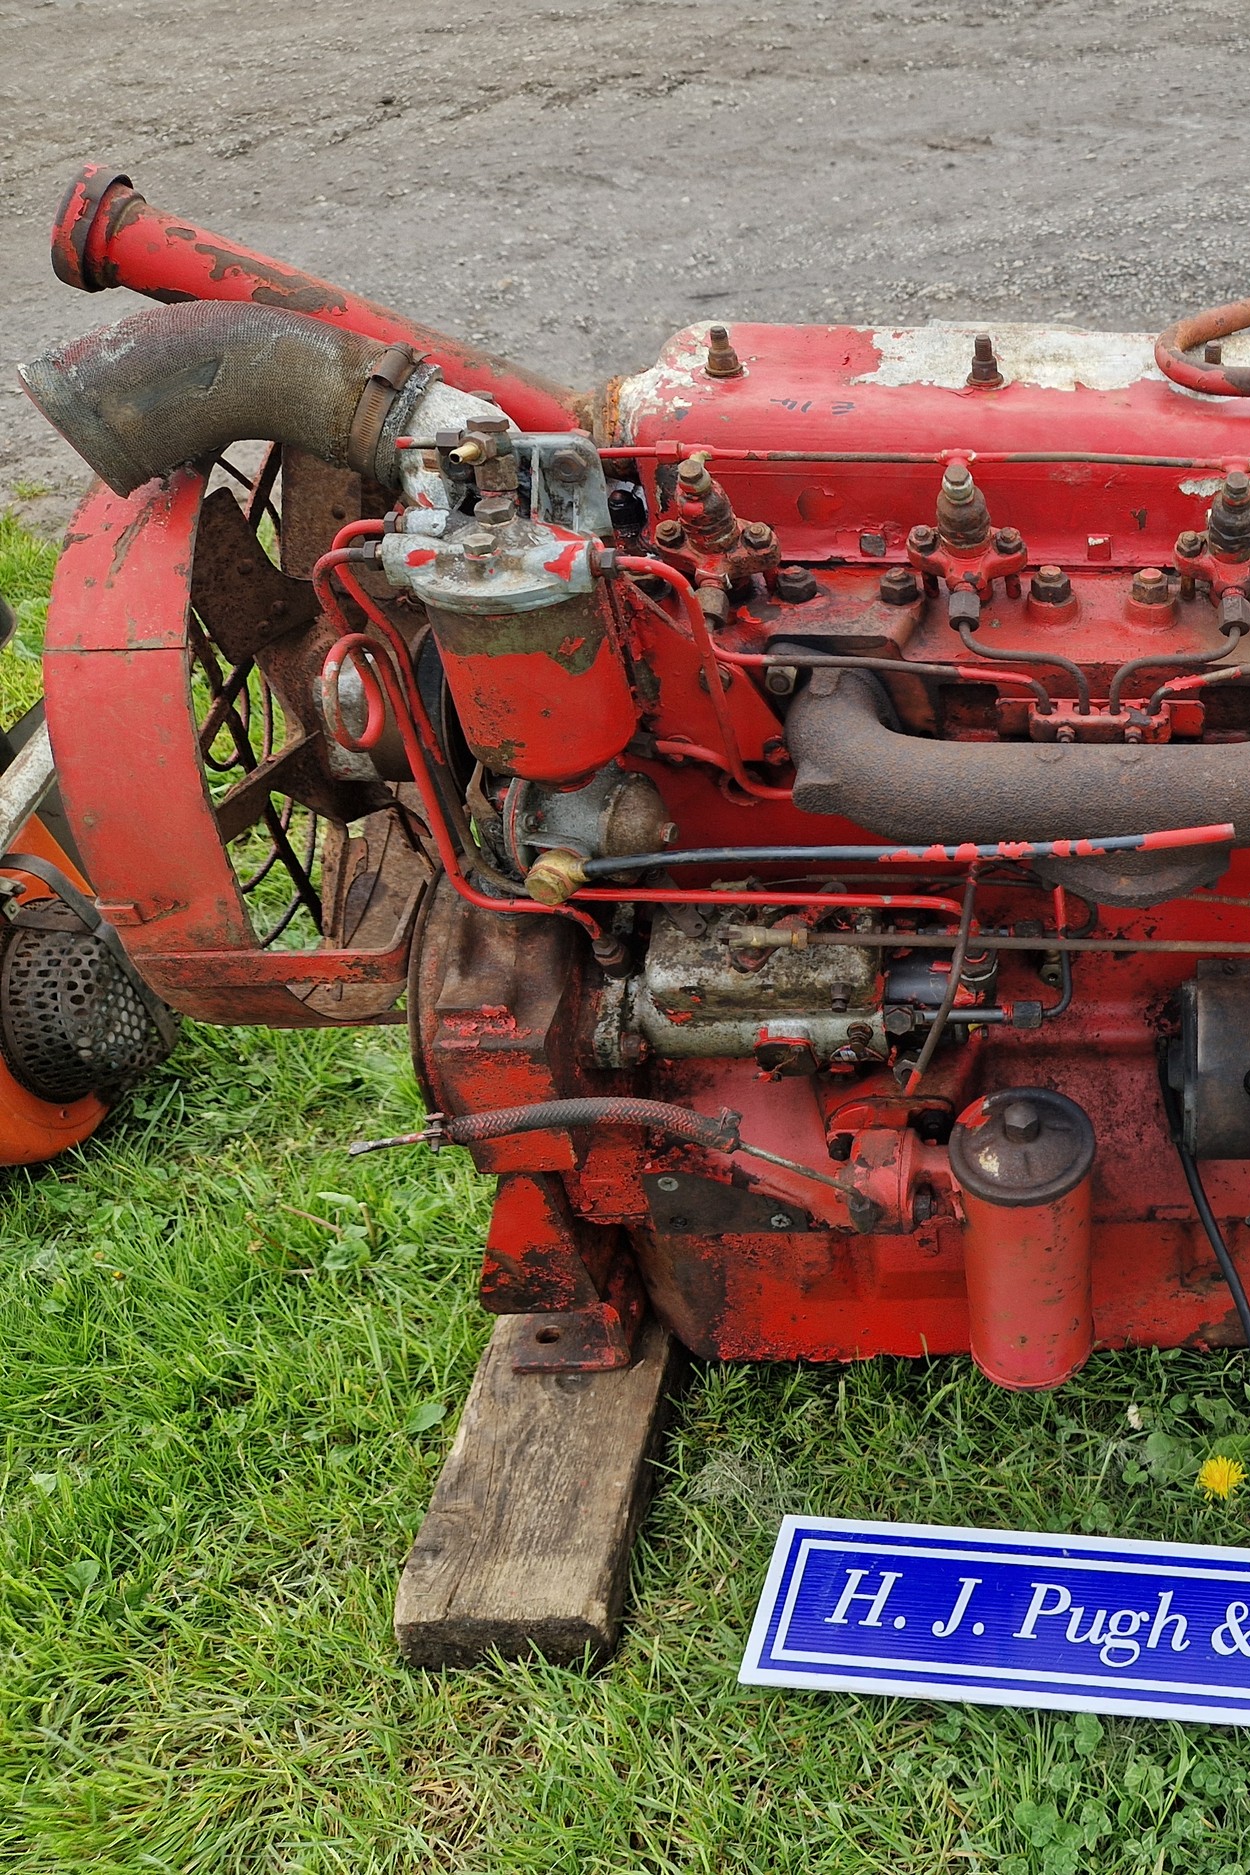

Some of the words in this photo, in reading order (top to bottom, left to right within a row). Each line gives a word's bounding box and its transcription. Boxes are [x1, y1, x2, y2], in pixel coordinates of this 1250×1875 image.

[823, 1568, 906, 1630] H.
[931, 1577, 985, 1637] J.
[1012, 1582, 1191, 1668] Pugh
